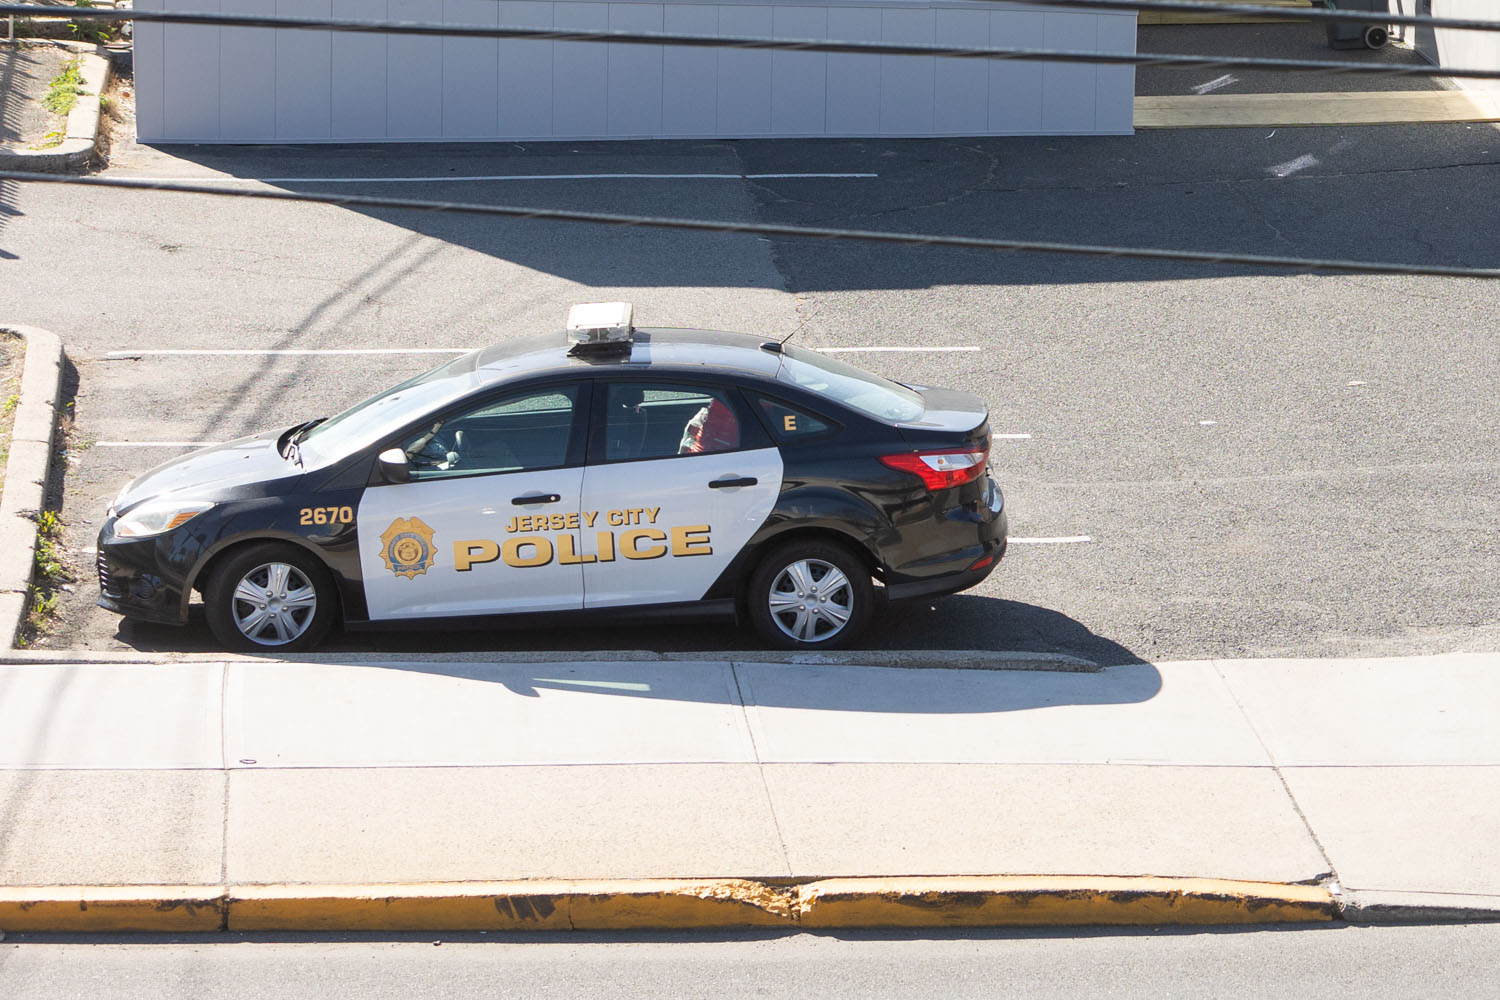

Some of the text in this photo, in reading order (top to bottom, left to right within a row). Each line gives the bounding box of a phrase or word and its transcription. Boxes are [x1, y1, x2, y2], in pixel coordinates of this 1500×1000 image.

[784, 415, 797, 431] E
[299, 505, 354, 526] 2670
[505, 506, 661, 533] JERSEY CITY
[453, 524, 713, 572] POLICE
